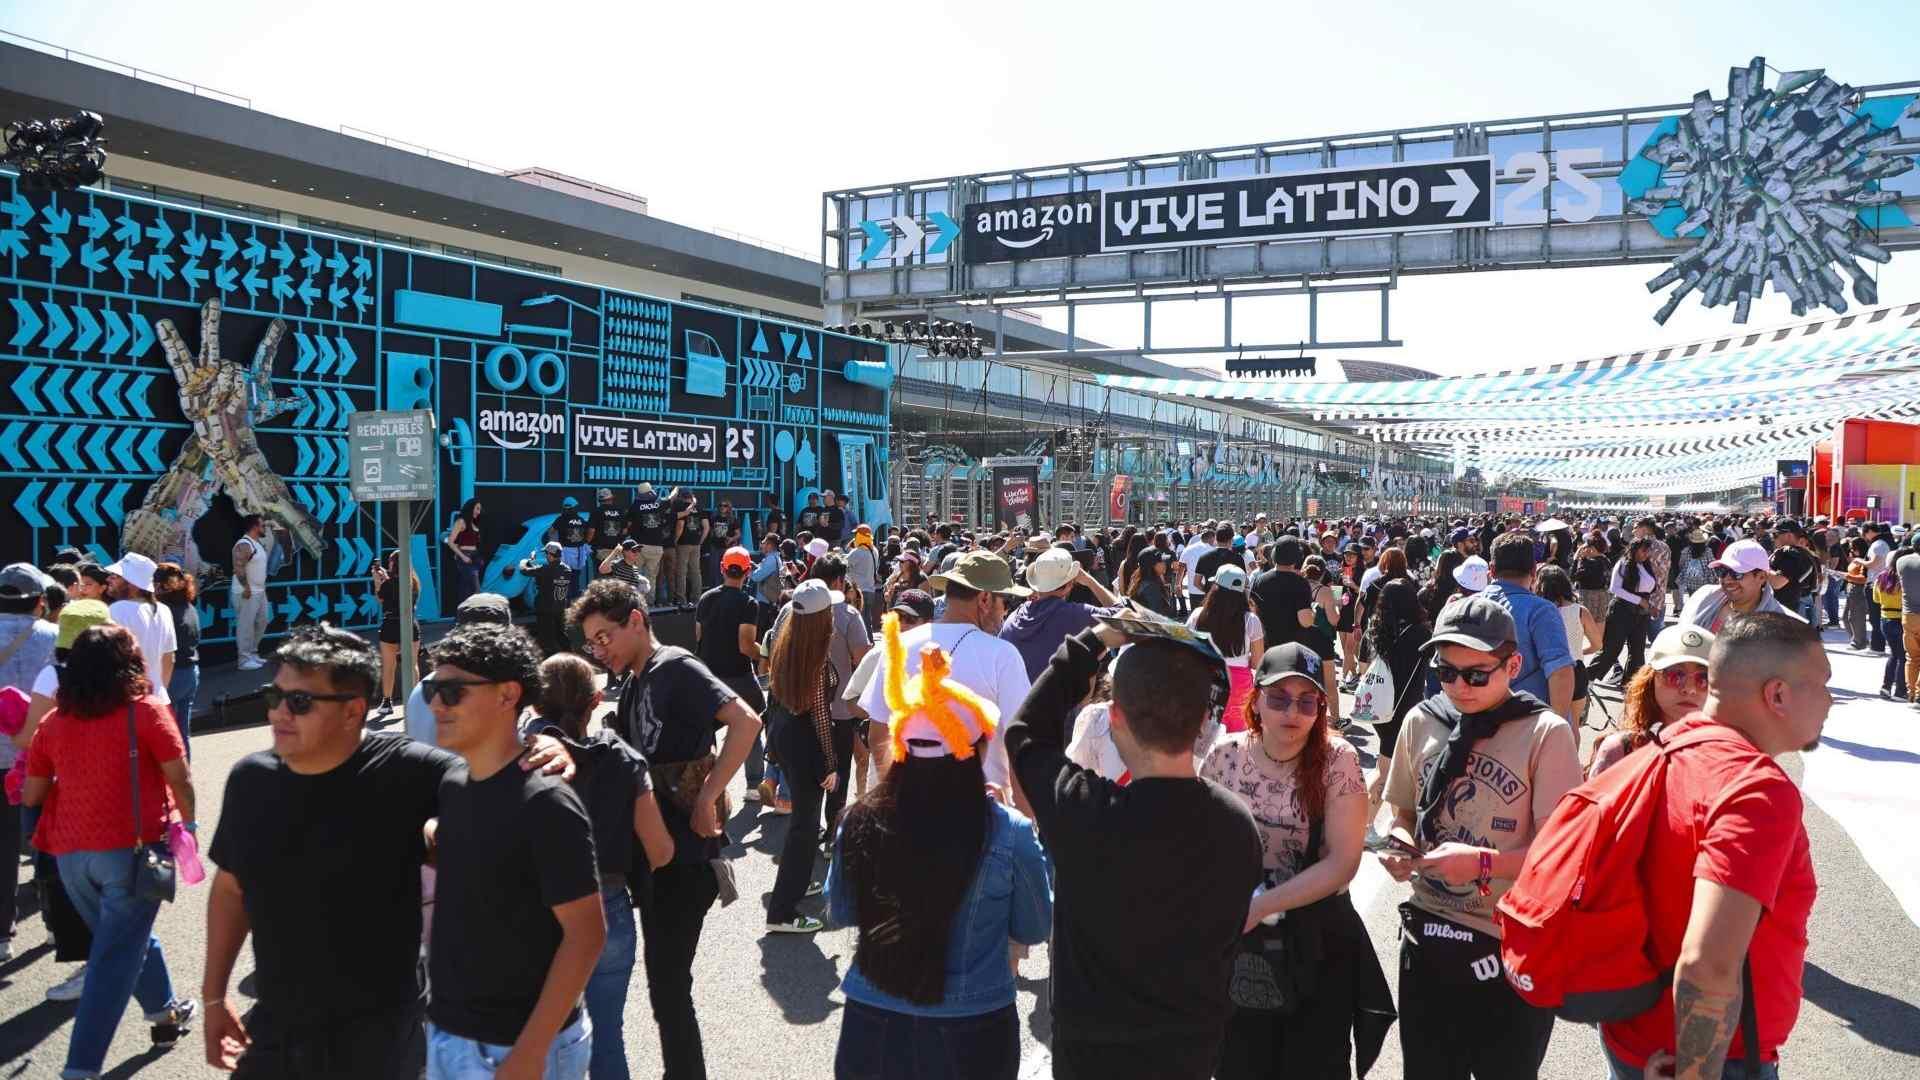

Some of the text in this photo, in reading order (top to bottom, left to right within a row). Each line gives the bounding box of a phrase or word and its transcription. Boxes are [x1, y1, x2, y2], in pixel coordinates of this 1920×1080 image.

[1502, 149, 1603, 225] 25
[977, 202, 1092, 233] amazon
[1114, 177, 1420, 237] VIVE LATINO
[357, 423, 424, 437] RECICLABLES
[479, 409, 565, 434] amazon
[579, 425, 698, 452] VIVE LATINO
[725, 427, 755, 460] 25
[1424, 922, 1473, 942] Wilson
[1470, 953, 1500, 981] W
